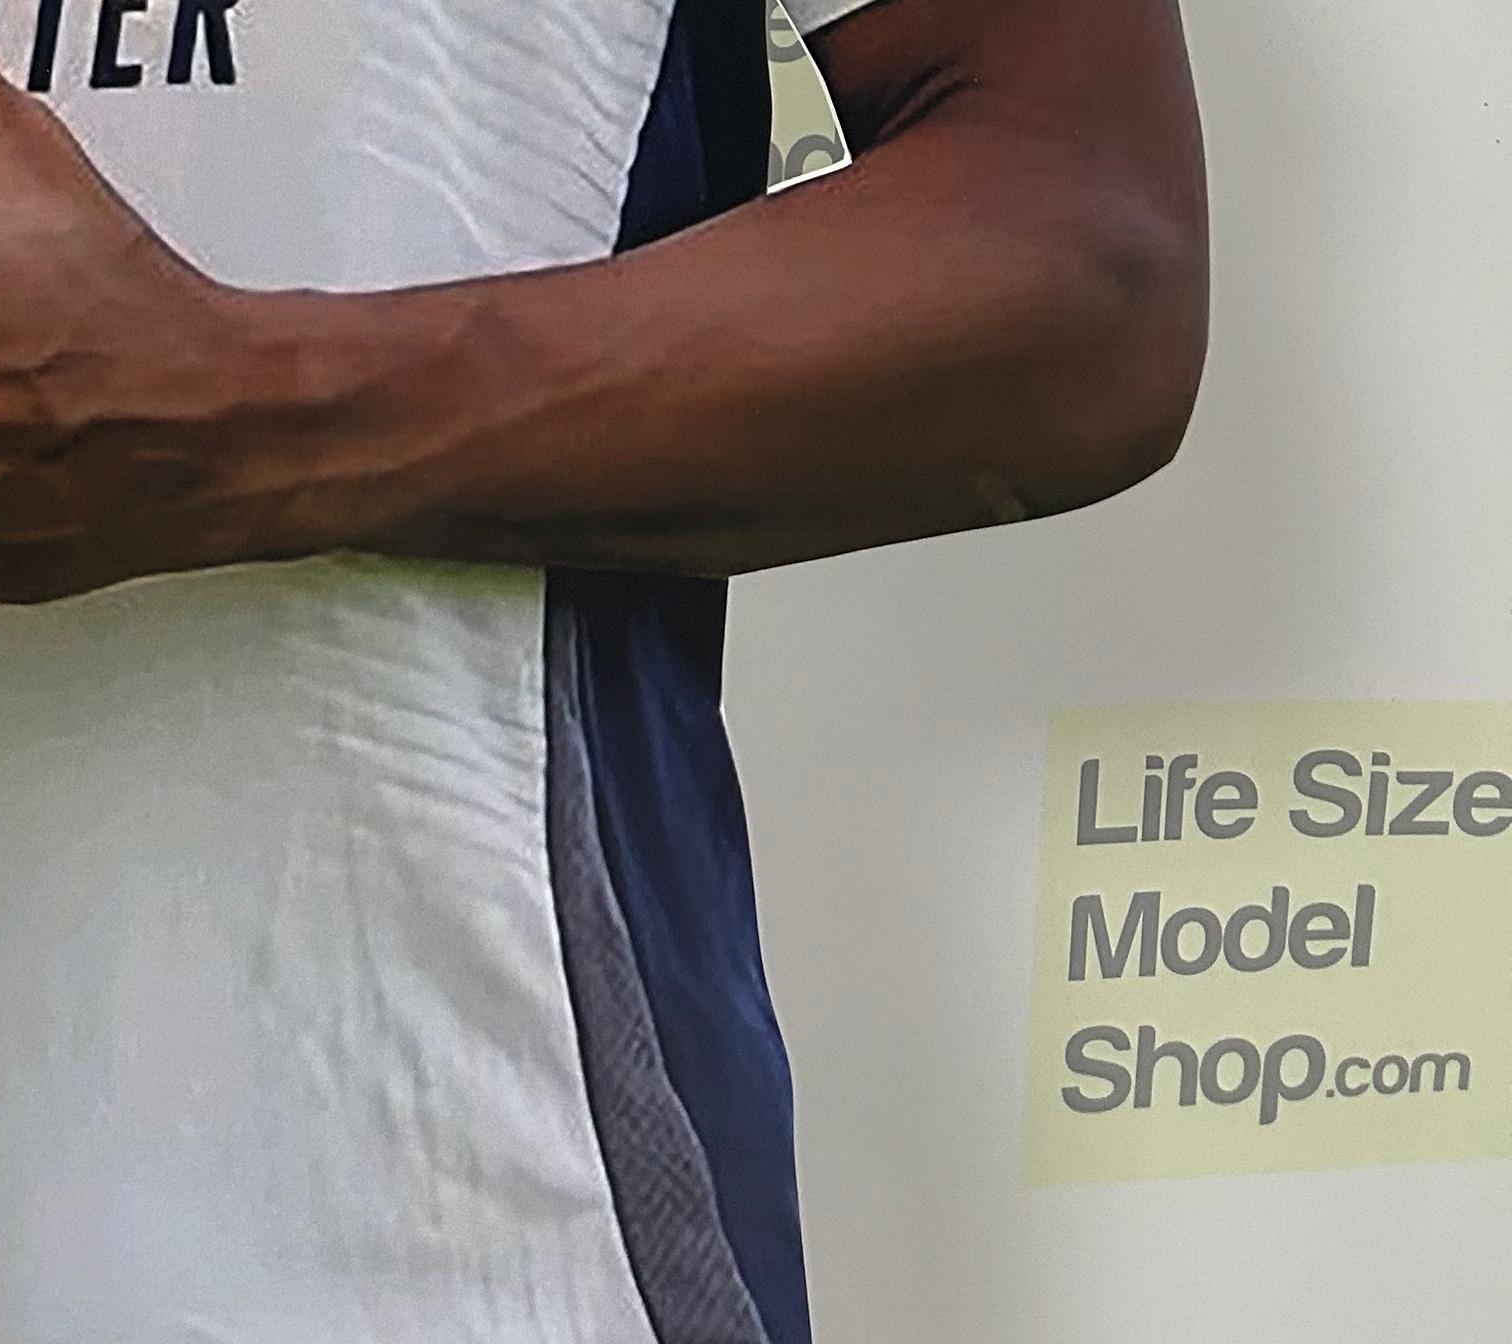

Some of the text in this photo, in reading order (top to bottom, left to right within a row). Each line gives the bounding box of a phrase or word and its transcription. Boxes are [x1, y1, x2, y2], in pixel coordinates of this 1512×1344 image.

[1077, 750, 1512, 846] Life Size
[1068, 884, 1376, 982] Model
[1061, 1025, 1471, 1125] Shop.com
